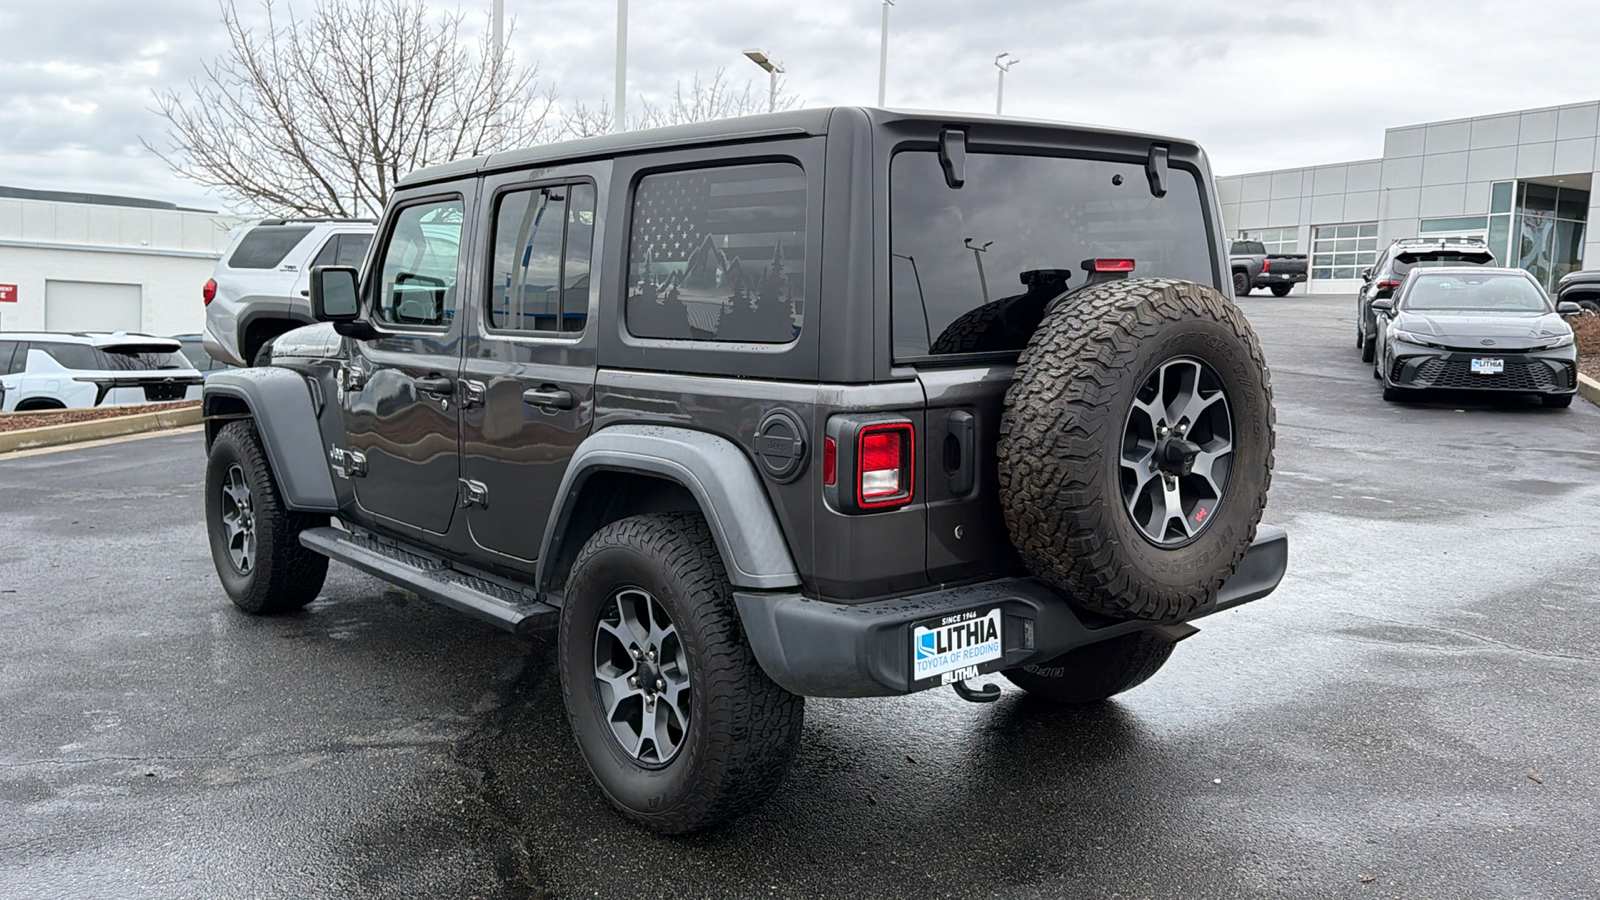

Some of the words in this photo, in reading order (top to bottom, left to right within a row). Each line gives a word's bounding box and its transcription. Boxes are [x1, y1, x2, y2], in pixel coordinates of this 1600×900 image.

[768, 441, 786, 453] Jeep
[942, 614, 961, 625] SINCE
[936, 617, 998, 655] LITHIA
[917, 655, 948, 672] TOYOTA
[950, 653, 961, 663] OF
[963, 642, 999, 660] REDDING
[951, 665, 979, 683] LITHIA
